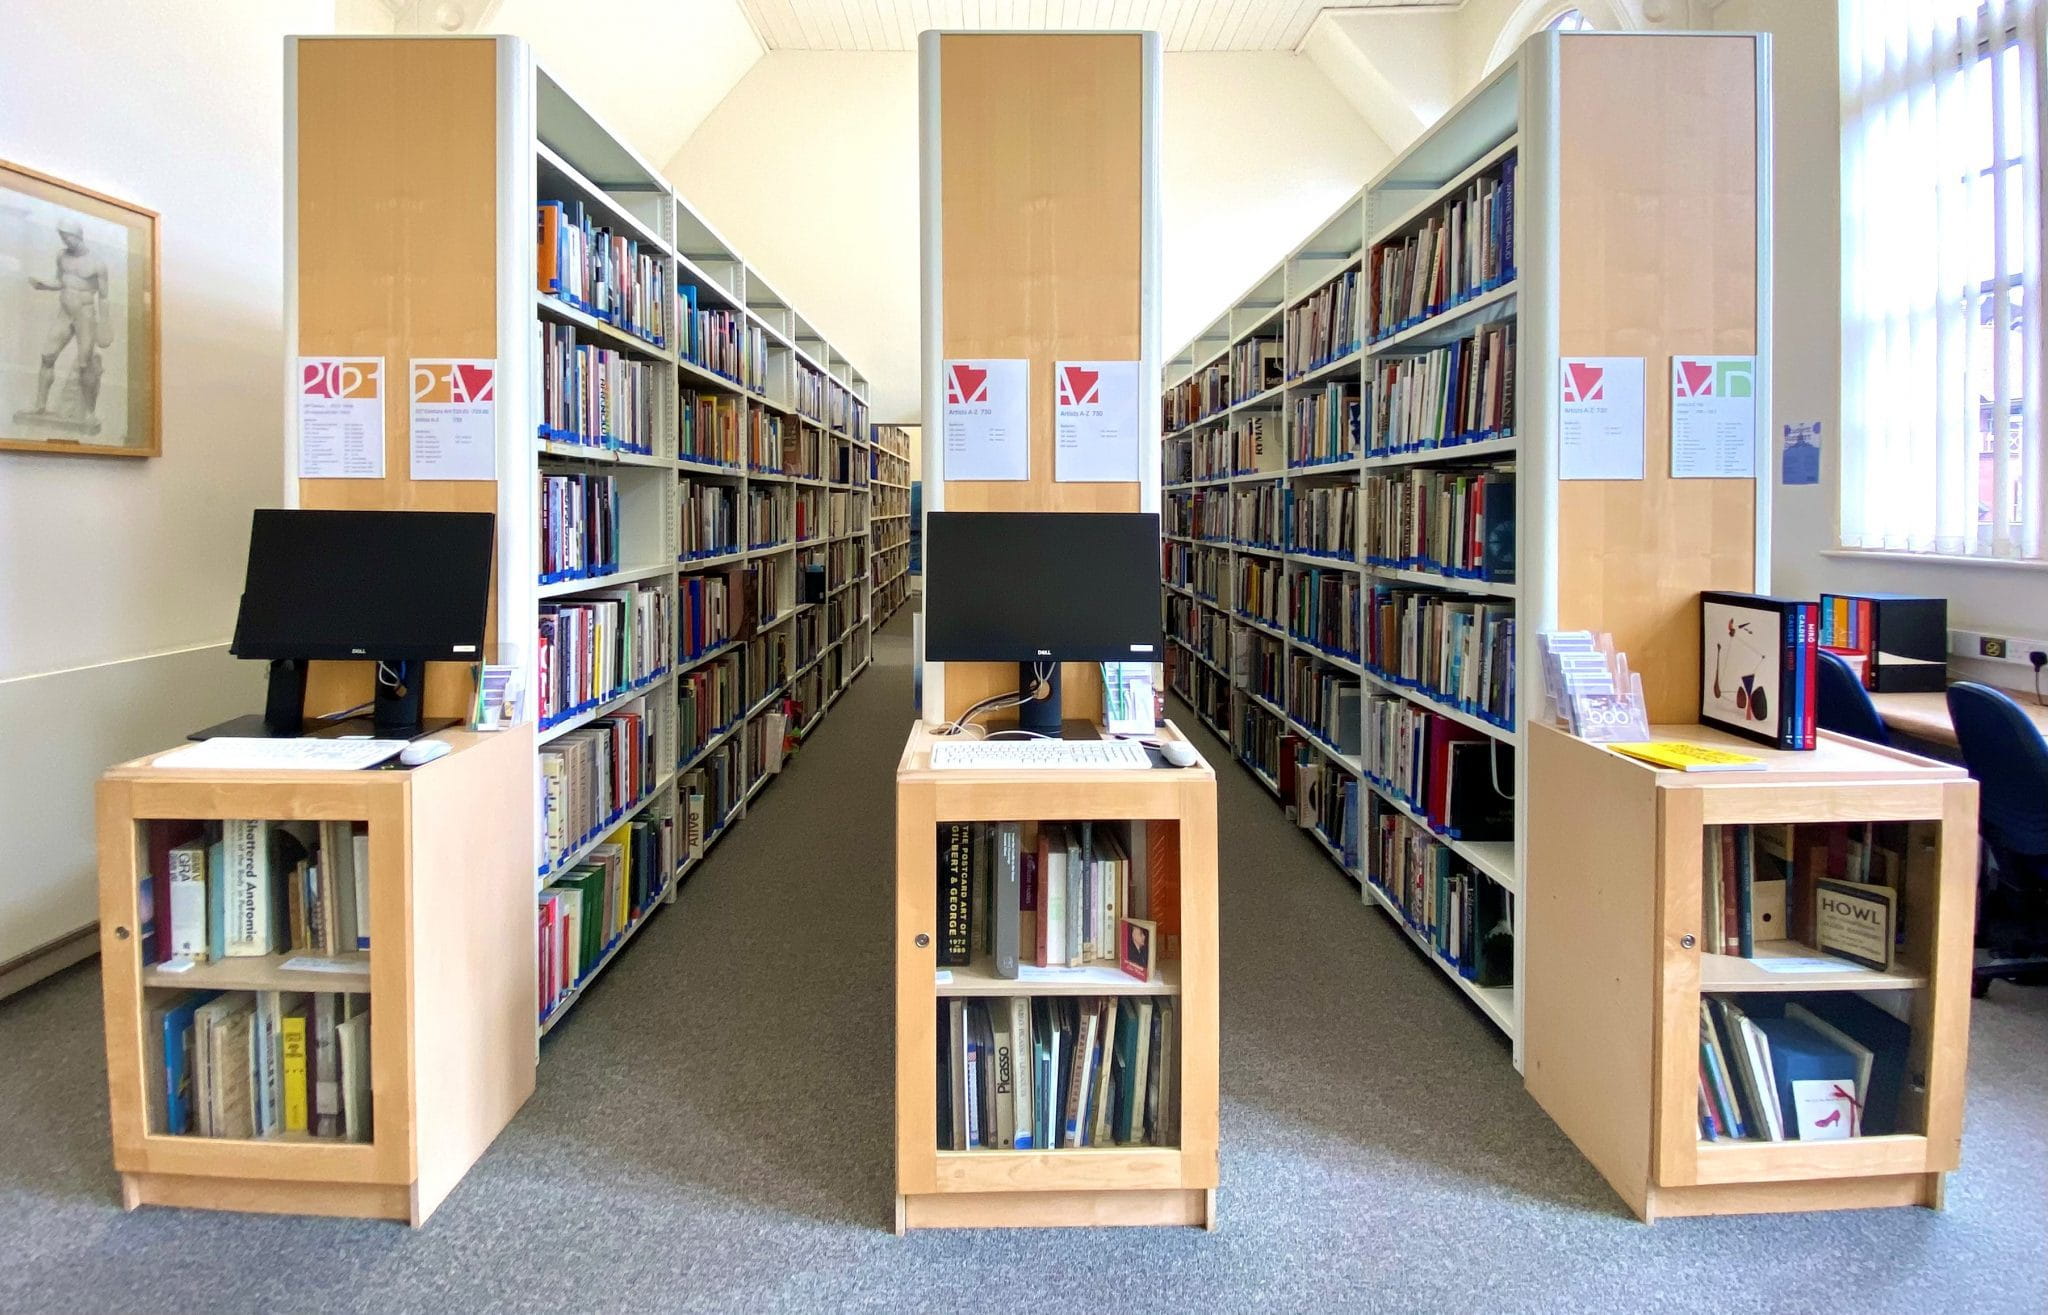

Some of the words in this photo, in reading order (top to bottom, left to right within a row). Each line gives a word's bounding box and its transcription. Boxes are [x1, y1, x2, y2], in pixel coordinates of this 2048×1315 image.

[688, 811, 700, 848] Alive
[951, 826, 959, 872] GILBERT
[949, 888, 957, 936] GEORGE
[960, 924, 966, 935] OF
[1822, 897, 1881, 925] HOWL
[997, 1047, 1010, 1094] Picasso
